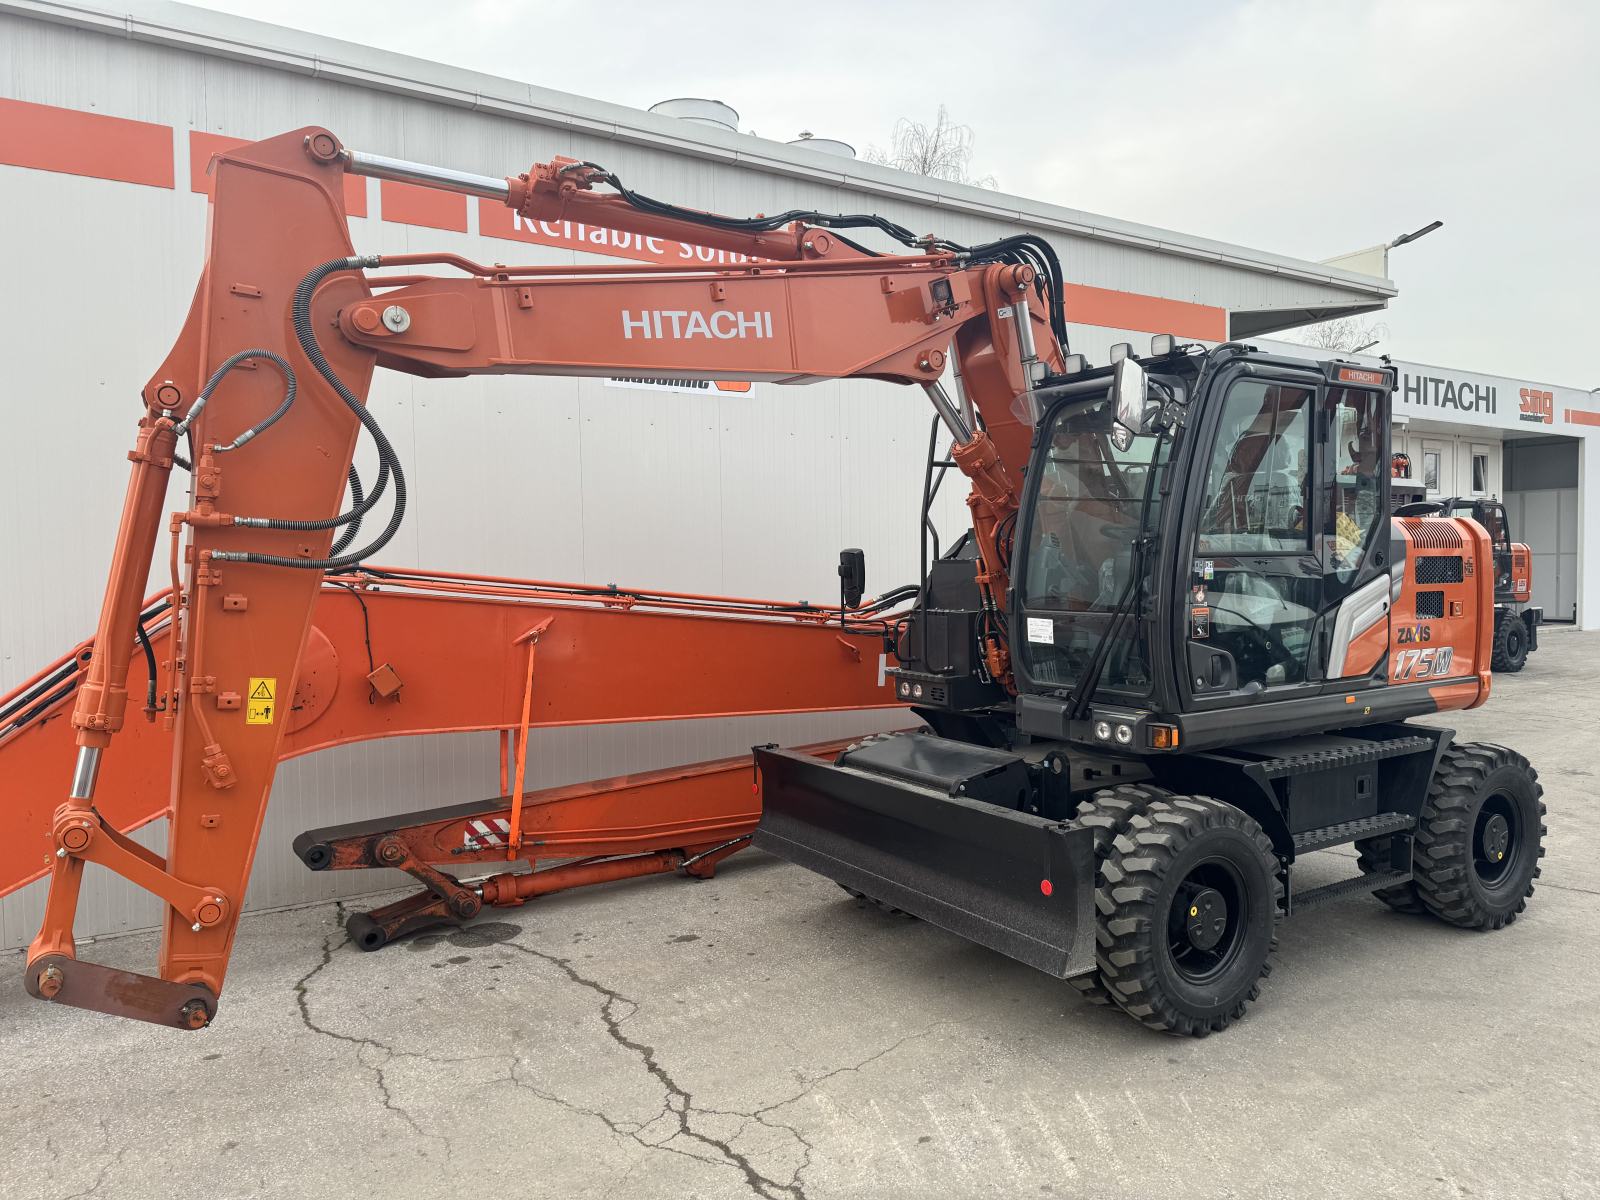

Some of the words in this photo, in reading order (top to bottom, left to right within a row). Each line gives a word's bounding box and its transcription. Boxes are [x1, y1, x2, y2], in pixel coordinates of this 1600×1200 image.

[621, 310, 773, 339] HITACHI
[1348, 371, 1375, 383] HITACHI
[1403, 373, 1497, 414] HITACHI
[1519, 388, 1554, 424] smg
[1397, 623, 1431, 644] ZAXIS
[1393, 646, 1454, 681] 175W
